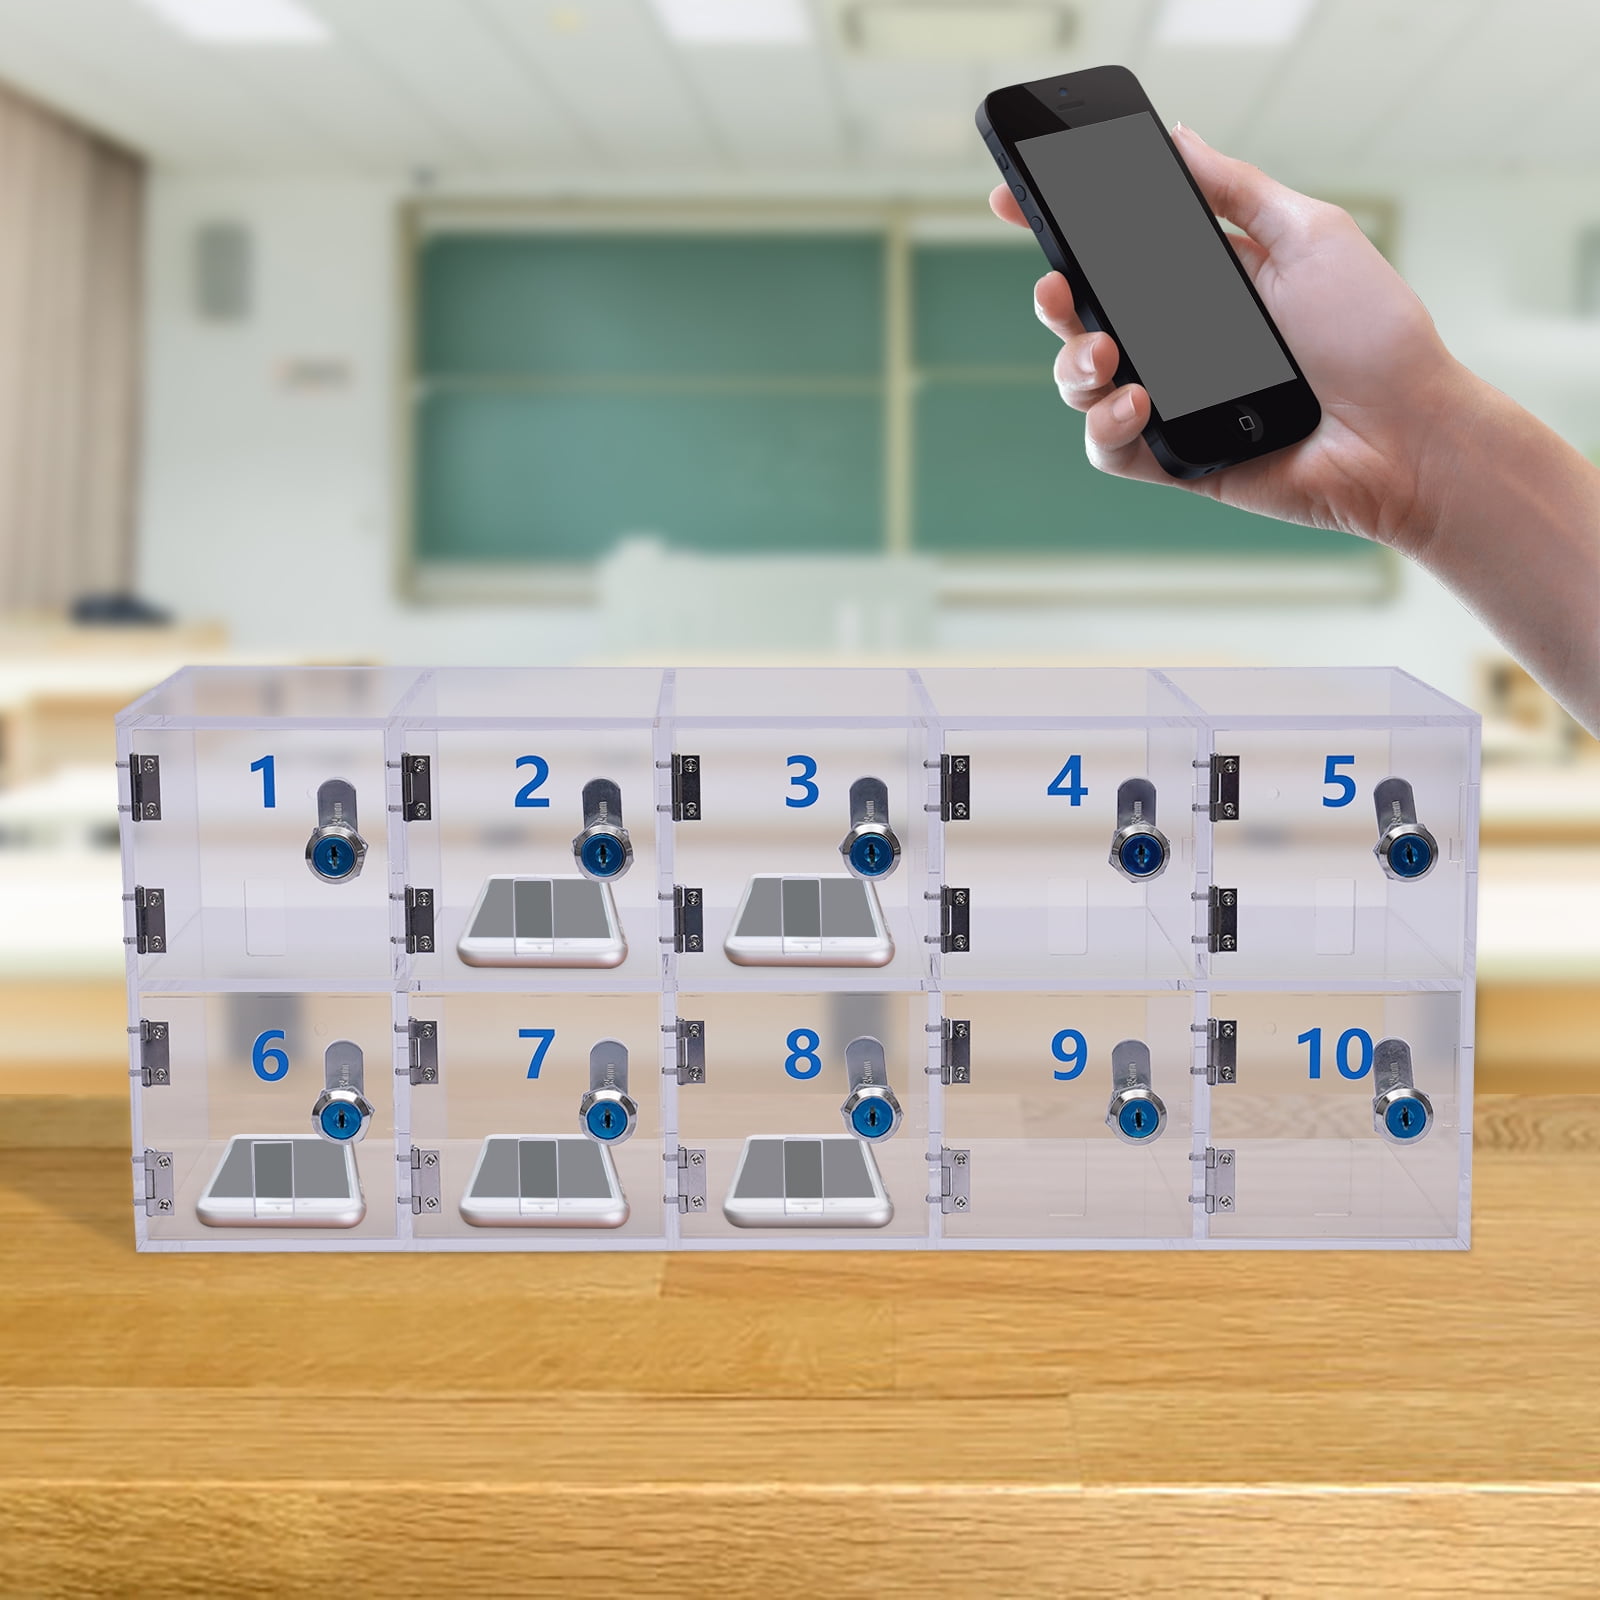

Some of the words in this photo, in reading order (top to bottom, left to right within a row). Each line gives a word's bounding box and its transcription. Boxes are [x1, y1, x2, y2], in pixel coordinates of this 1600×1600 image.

[250, 755, 276, 809] 1
[514, 755, 550, 808] 2
[785, 755, 819, 809] 3
[1047, 755, 1089, 807] 4
[1322, 755, 1356, 808] 5
[252, 1029, 289, 1082] 6
[518, 1029, 555, 1079] 7
[784, 1028, 822, 1080] 8
[1051, 1029, 1088, 1081] 9
[1297, 1027, 1374, 1080] 10
